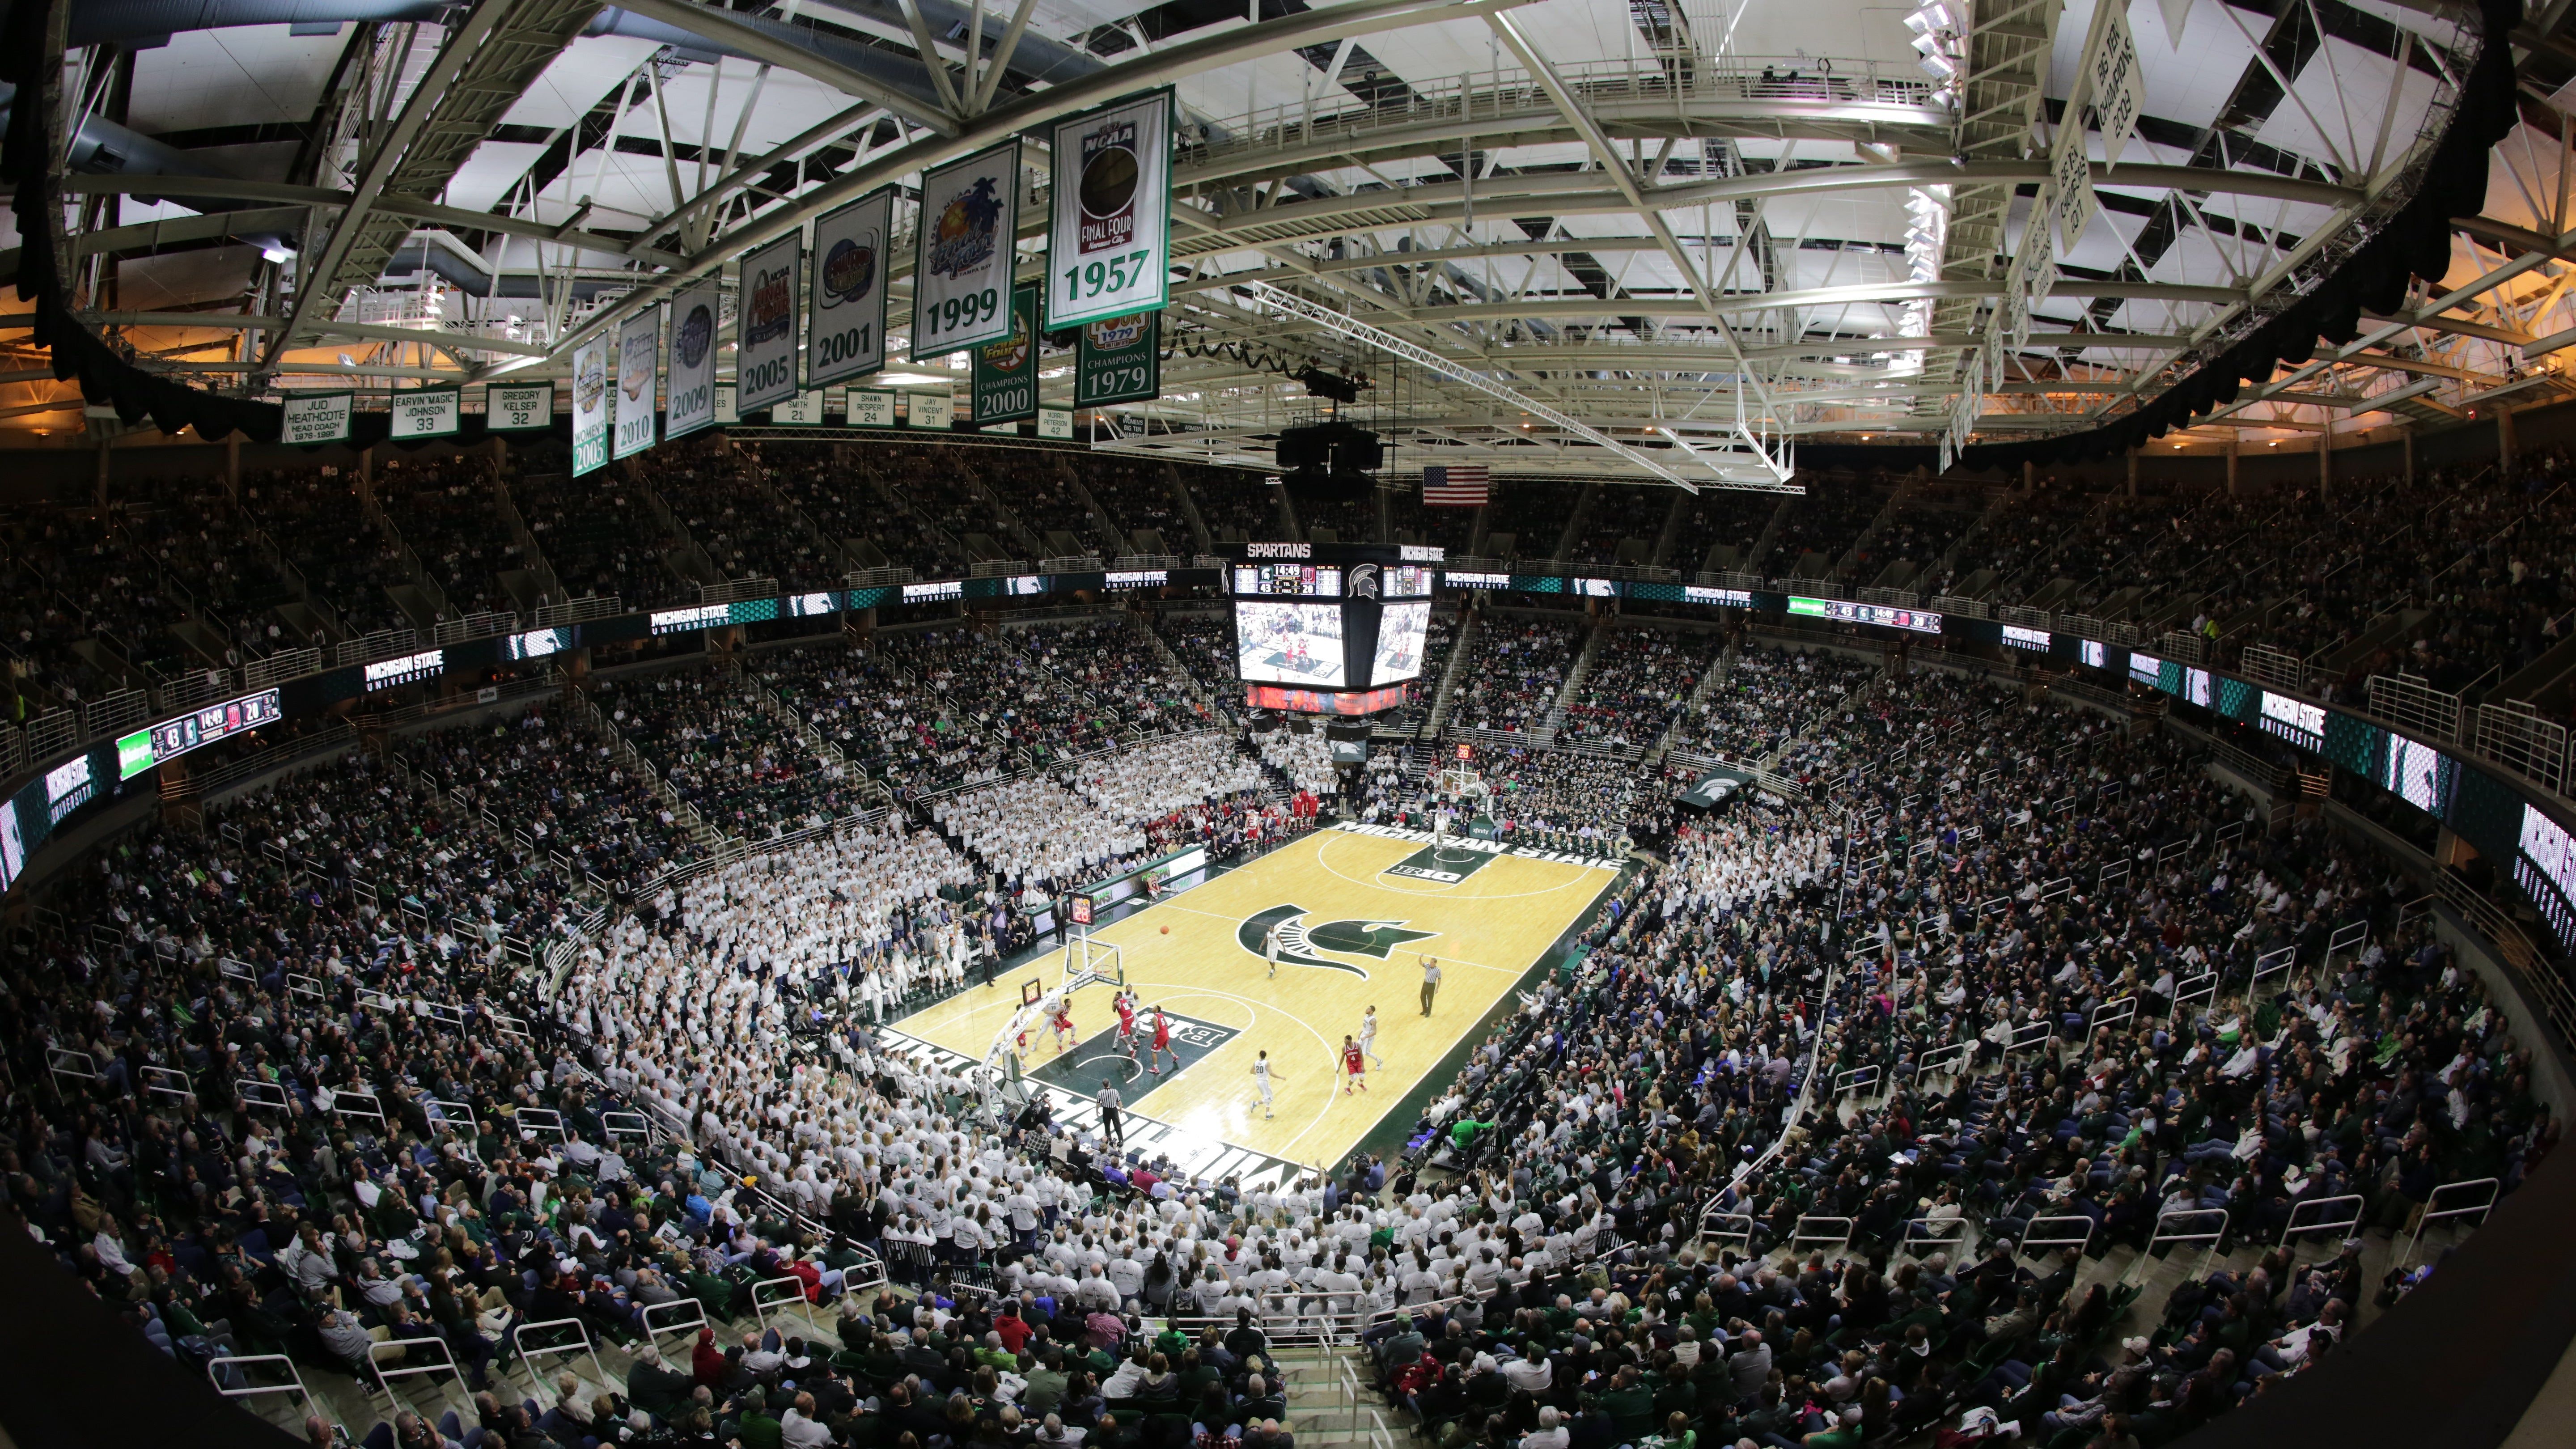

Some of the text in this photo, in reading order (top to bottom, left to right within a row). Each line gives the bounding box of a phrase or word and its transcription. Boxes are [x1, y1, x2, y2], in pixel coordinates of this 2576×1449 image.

[2097, 17, 2120, 87] BIG TEN
[2113, 89, 2131, 139] 2009
[1084, 127, 1133, 153] NCAA
[1082, 215, 1132, 243] FINAL FOUR
[929, 217, 983, 274] Final
[948, 226, 999, 280] Four
[770, 266, 789, 282] NCAA
[959, 263, 992, 277] TAMPA BAY
[1065, 250, 1150, 301] 1957
[754, 277, 789, 310] FINAL
[927, 288, 998, 335] 1999
[1102, 327, 1133, 341] 1979
[818, 322, 870, 368] 2001
[1088, 352, 1146, 370] CHAMPIONS
[746, 355, 788, 396] 2005
[981, 375, 1028, 391] CHAMPIONS
[1089, 366, 1146, 396] 1979
[396, 394, 456, 407] EARVIN "MAGIC"
[502, 391, 541, 401] GREGORY
[672, 384, 707, 420] 2009
[982, 388, 1028, 416] 2000
[307, 400, 328, 411] JUD
[406, 406, 445, 417] JOHNSON
[504, 402, 537, 411] KELSER
[287, 410, 346, 424] HEATHCOTE
[512, 413, 528, 425] 32
[792, 411, 803, 420] 21
[864, 413, 877, 422] 24
[925, 416, 936, 424] 31
[1123, 418, 1143, 426] WOMEN'S
[292, 422, 340, 432] HEAD COACH
[416, 418, 434, 431] 33
[621, 415, 649, 447] 2010
[1051, 427, 1060, 435] 42
[294, 430, 335, 440] 1976-1995
[575, 420, 606, 445] WOMEN'S
[576, 438, 603, 471] 2005
[1247, 543, 1311, 558] SPARTANS
[1400, 545, 1445, 562] MICHIGAN STATE
[1106, 571, 1167, 583] MICHIGAN STATE
[1275, 566, 1300, 576] 14:49
[1403, 568, 1415, 577] 14:49
[1445, 572, 1510, 584] MICHIGAN STATE
[903, 581, 962, 597] MICHIGAN STATE
[1106, 580, 1167, 589] UNIVERSITY
[1260, 584, 1271, 593] 43
[1302, 585, 1313, 594] 20
[1396, 585, 1402, 594] 43
[1445, 581, 1510, 589] UNIVERSITY
[903, 593, 962, 605] UNIVERSITY
[1685, 586, 1751, 602] MICHIGAN STATE
[1685, 596, 1751, 608] UNIVERSITY
[651, 604, 729, 627] MICHIGAN STATE
[1841, 607, 1852, 617] 43
[1875, 609, 1894, 618] 14:49
[652, 618, 729, 636] UNIVERSITY
[1914, 616, 1924, 626] 20
[2002, 625, 2051, 646] MICHIGAN STATE
[2002, 638, 2049, 653] UNIVERSITY
[365, 650, 443, 682] MICHIGAN STATE
[367, 667, 443, 692] UNIVERSITY
[201, 709, 223, 729] 14:49
[246, 703, 259, 720] 20
[2261, 691, 2326, 737] MICHIGAN STATE
[168, 729, 179, 748] 43
[202, 730, 218, 741] PERIOD
[2260, 717, 2322, 753] UNIVERSITY
[1458, 749, 1468, 758] 28
[1331, 821, 1512, 853] MICHIGAN
[1075, 906, 1089, 921] 28
[1028, 991, 1036, 1000] 28
[1003, 1021, 1030, 1049] msuspartans.com
[1256, 1065, 1263, 1073] 20
